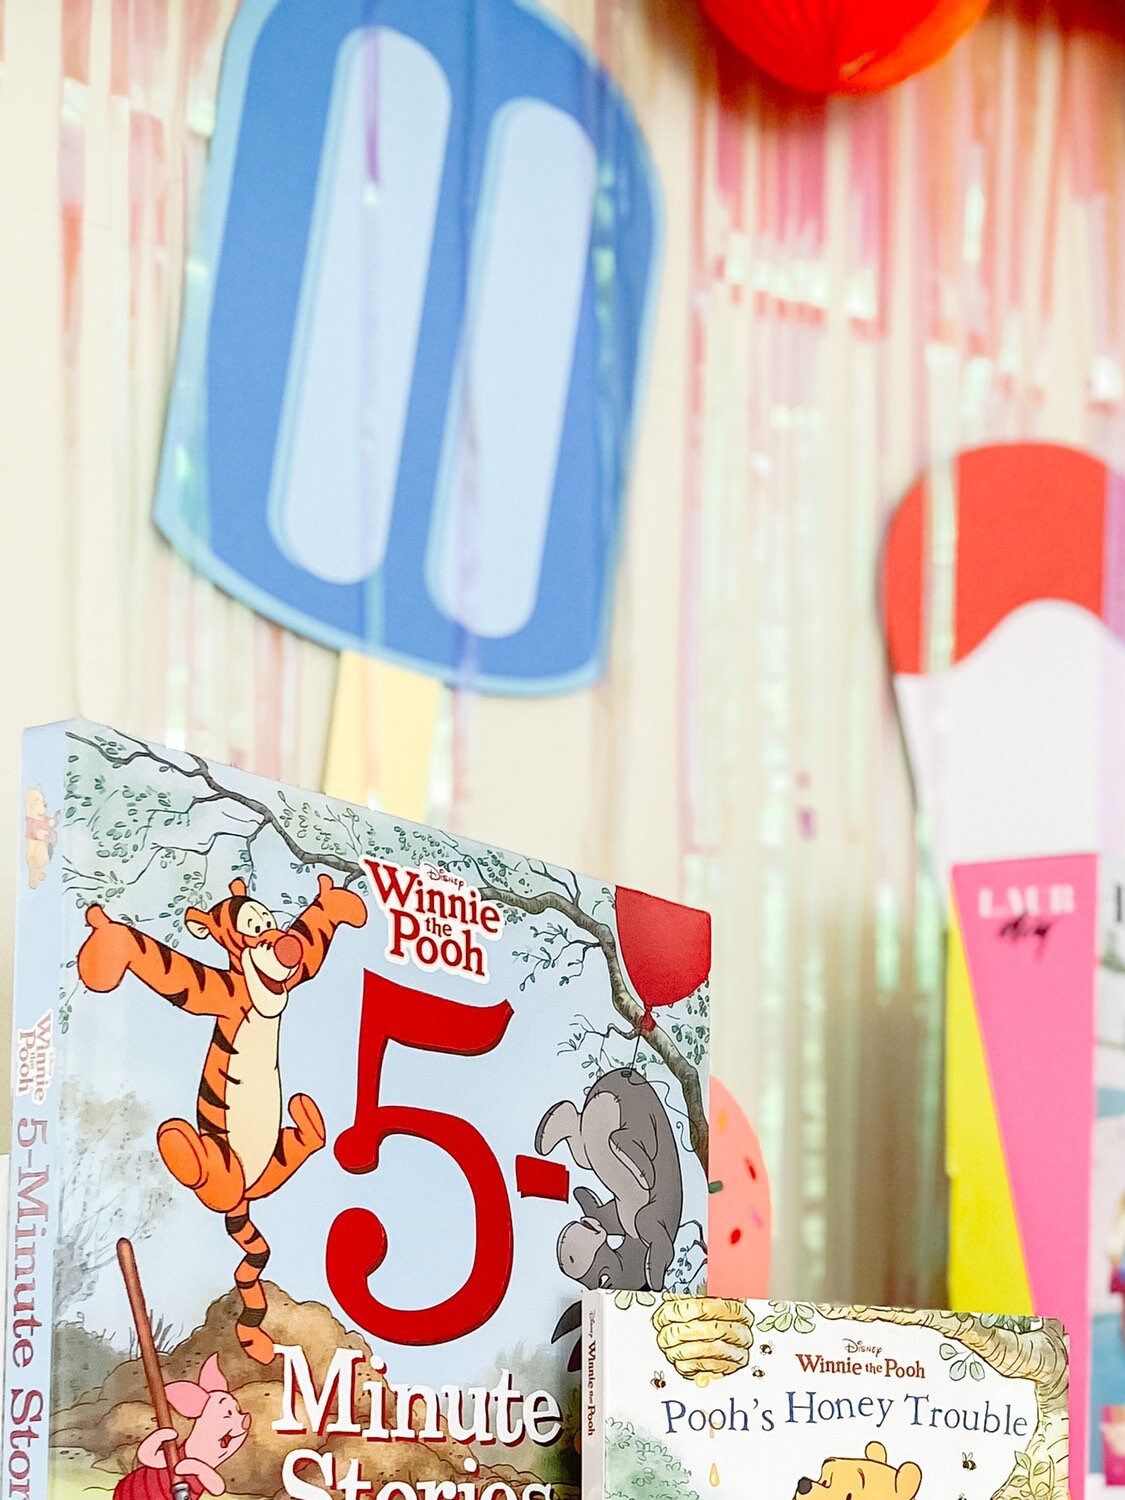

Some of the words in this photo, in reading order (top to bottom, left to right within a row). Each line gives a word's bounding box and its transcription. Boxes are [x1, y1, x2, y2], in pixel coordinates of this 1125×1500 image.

[364, 859, 500, 933] Winnie
[425, 917, 452, 937] the
[389, 908, 485, 976] Pooh
[19, 1029, 36, 1093] Pooh
[36, 1012, 51, 1102] Winnie
[272, 1344, 563, 1448] Minute
[795, 1353, 862, 1376] Winnie
[865, 1361, 883, 1374] the
[884, 1361, 926, 1379] Pooh
[588, 1405, 596, 1436] Pooh
[661, 1397, 775, 1434] Pooh's
[785, 1391, 894, 1428] Honey
[904, 1393, 1028, 1437] Trouble
